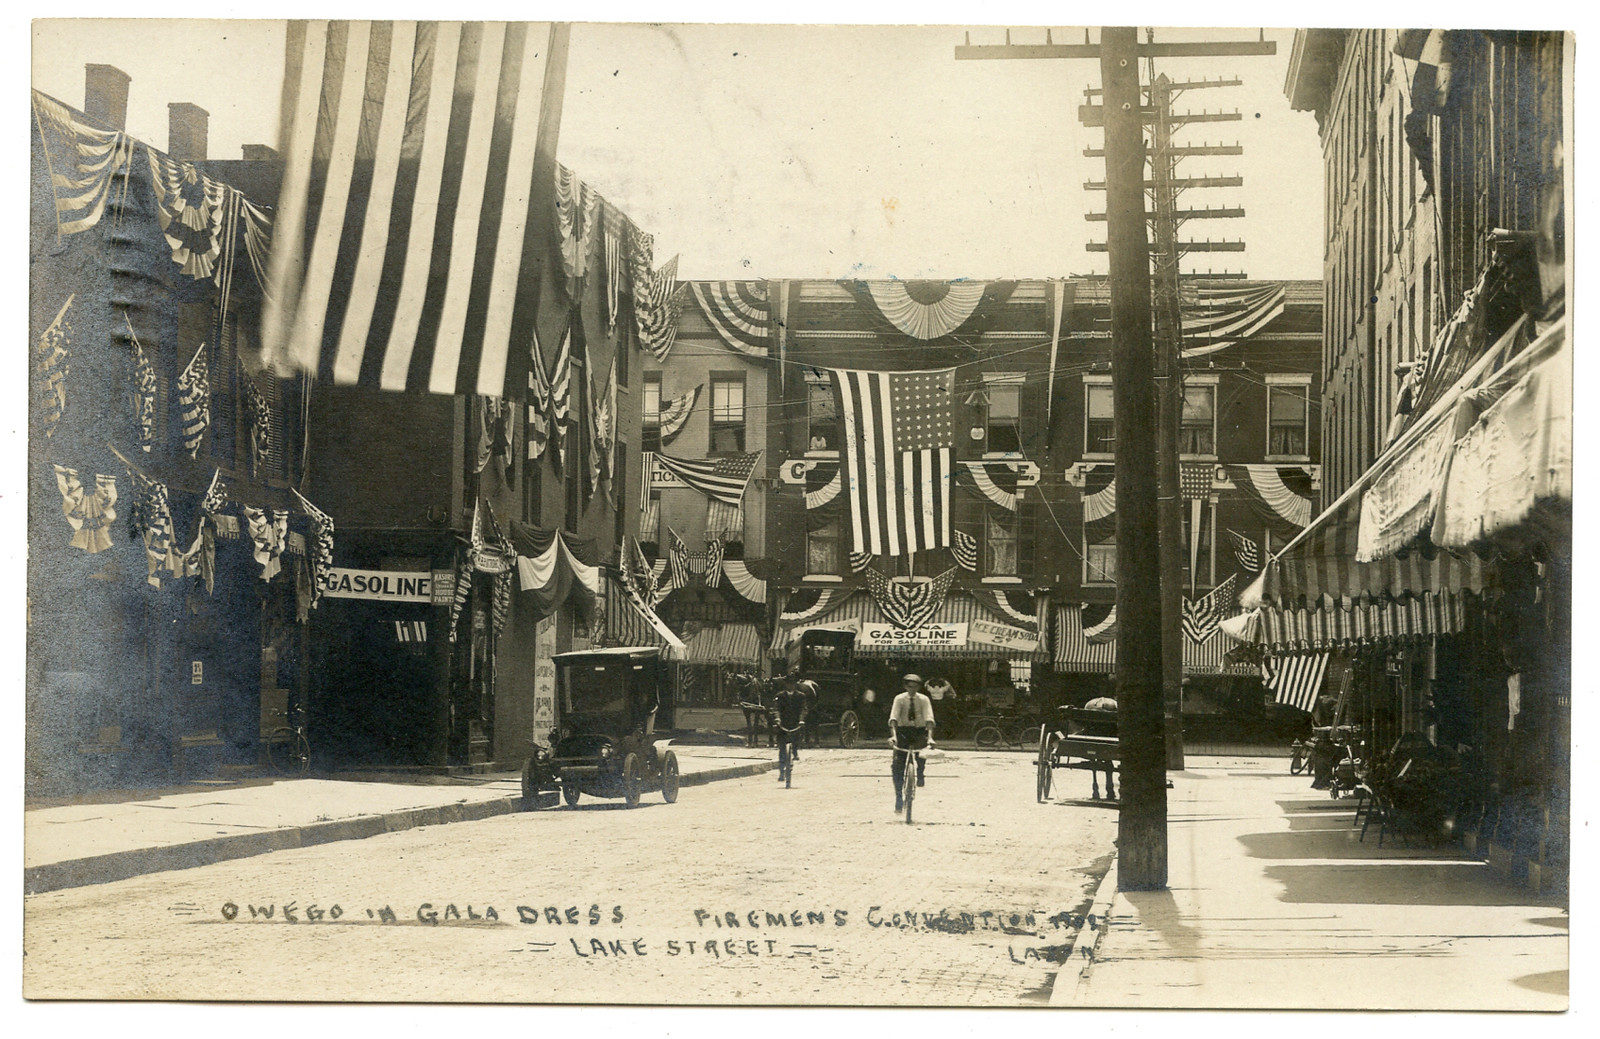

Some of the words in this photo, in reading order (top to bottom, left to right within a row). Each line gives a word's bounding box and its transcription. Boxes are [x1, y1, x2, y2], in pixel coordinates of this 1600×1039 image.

[326, 573, 430, 596] GASOLINE
[870, 630, 957, 639] GASOLINE
[975, 622, 989, 633] ICE
[990, 626, 1019, 638] CREAM
[1188, 666, 1216, 674] SHOE
[1222, 667, 1255, 675] STORE
